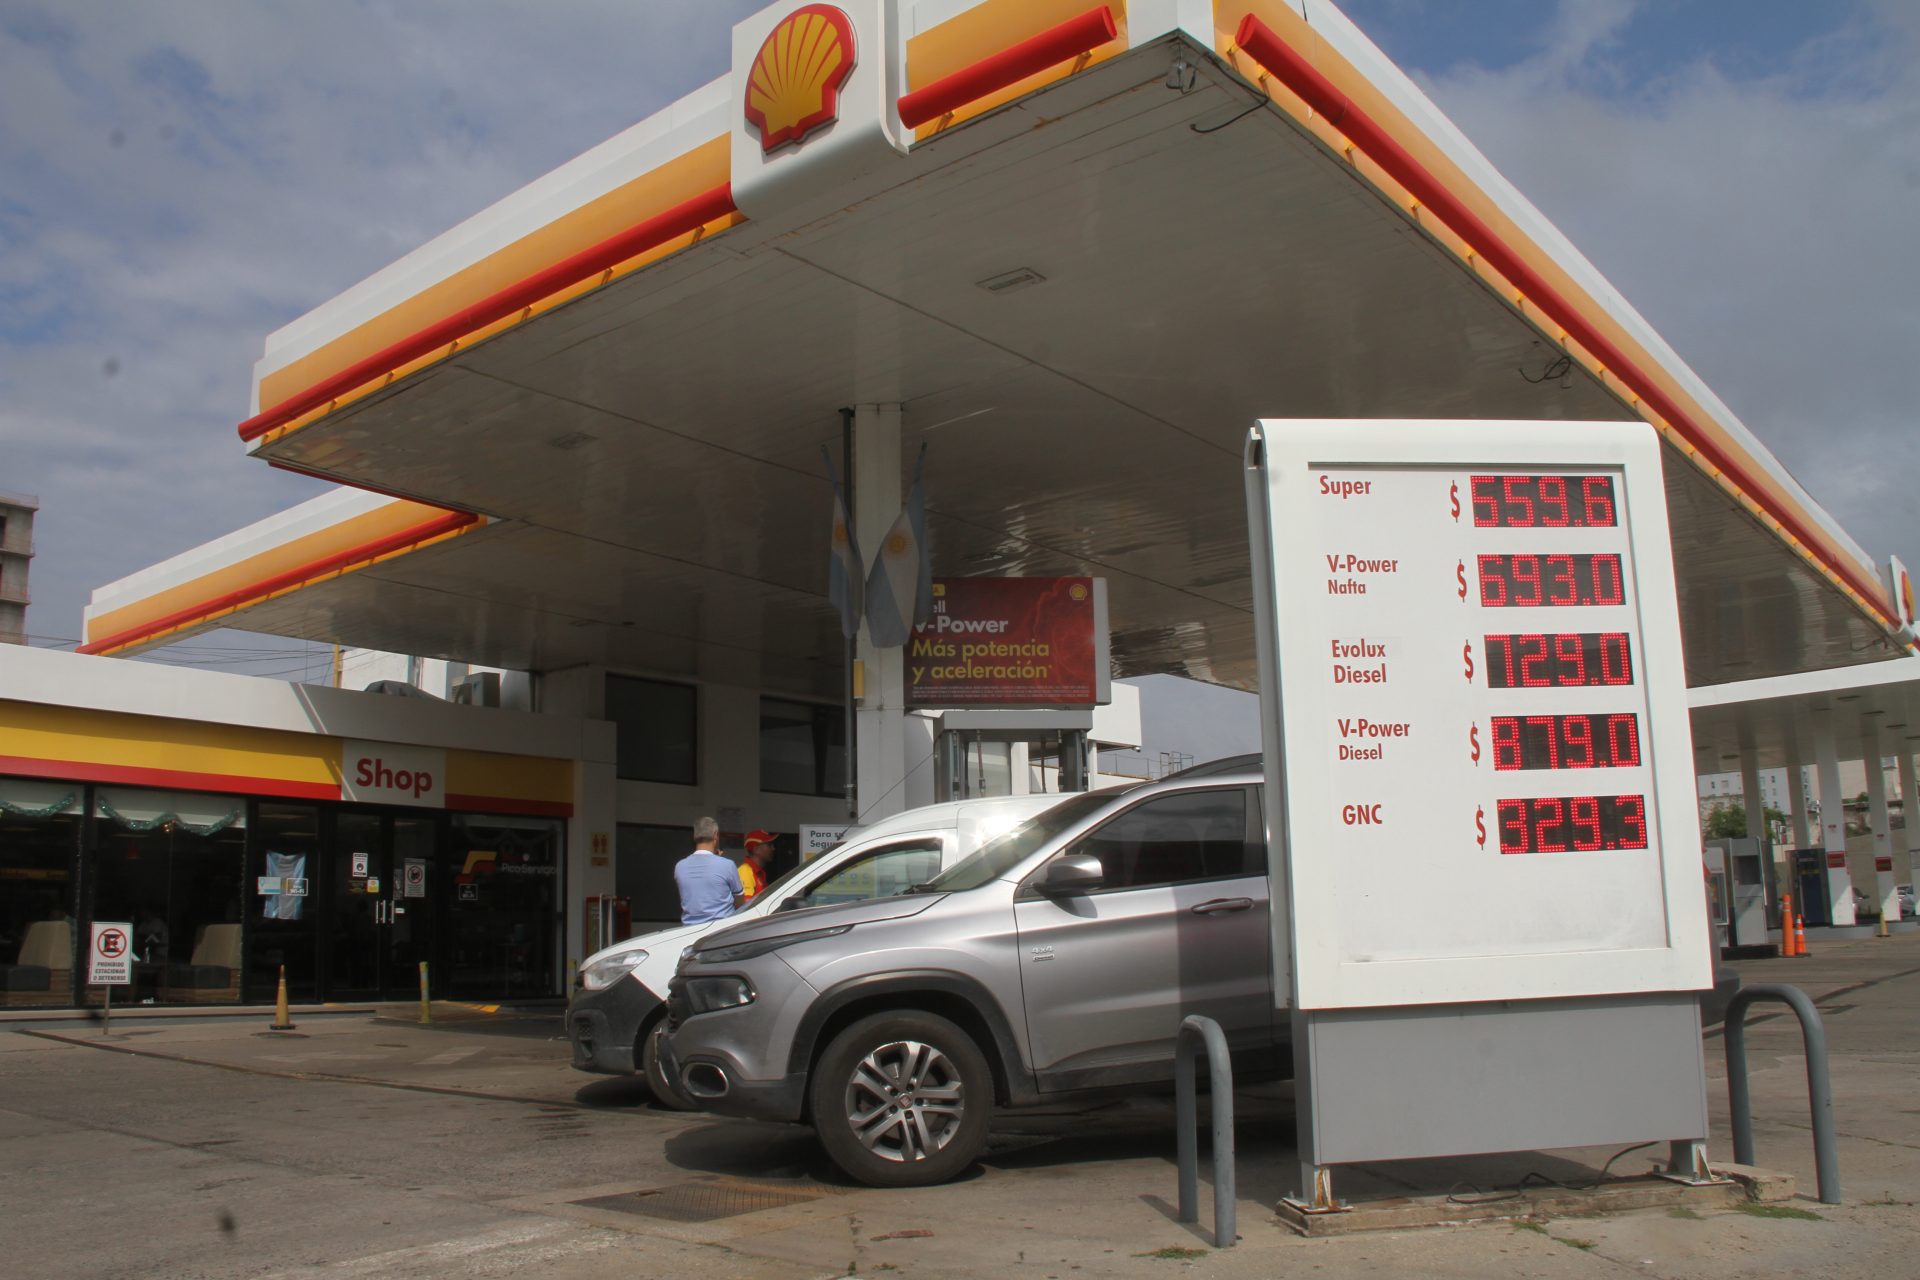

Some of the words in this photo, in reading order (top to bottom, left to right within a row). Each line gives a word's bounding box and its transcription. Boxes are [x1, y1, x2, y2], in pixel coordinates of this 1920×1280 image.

[1319, 475, 1371, 500] Super
[1449, 481, 1461, 522] $
[1470, 475, 1614, 528] 559.6
[1327, 555, 1398, 573] V-Power
[1327, 580, 1366, 594] Nafta
[1456, 560, 1468, 602] $
[1477, 553, 1623, 607] 693.0
[911, 638, 956, 657] Más
[961, 639, 1050, 661] potencia
[1331, 639, 1386, 658] Evolux
[1463, 640, 1475, 684] $
[1484, 631, 1634, 688] 729.0
[911, 666, 925, 685] y
[1333, 664, 1387, 684] Diesel
[1337, 719, 1410, 738] V-Power
[1469, 722, 1481, 766] $
[1490, 714, 1641, 772] 879.0
[1338, 744, 1383, 761] Diesel
[355, 758, 433, 799] Shop
[810, 829, 832, 838] Para
[1342, 804, 1383, 826] GNC
[1475, 805, 1487, 850] $
[1496, 794, 1648, 855] 329.3
